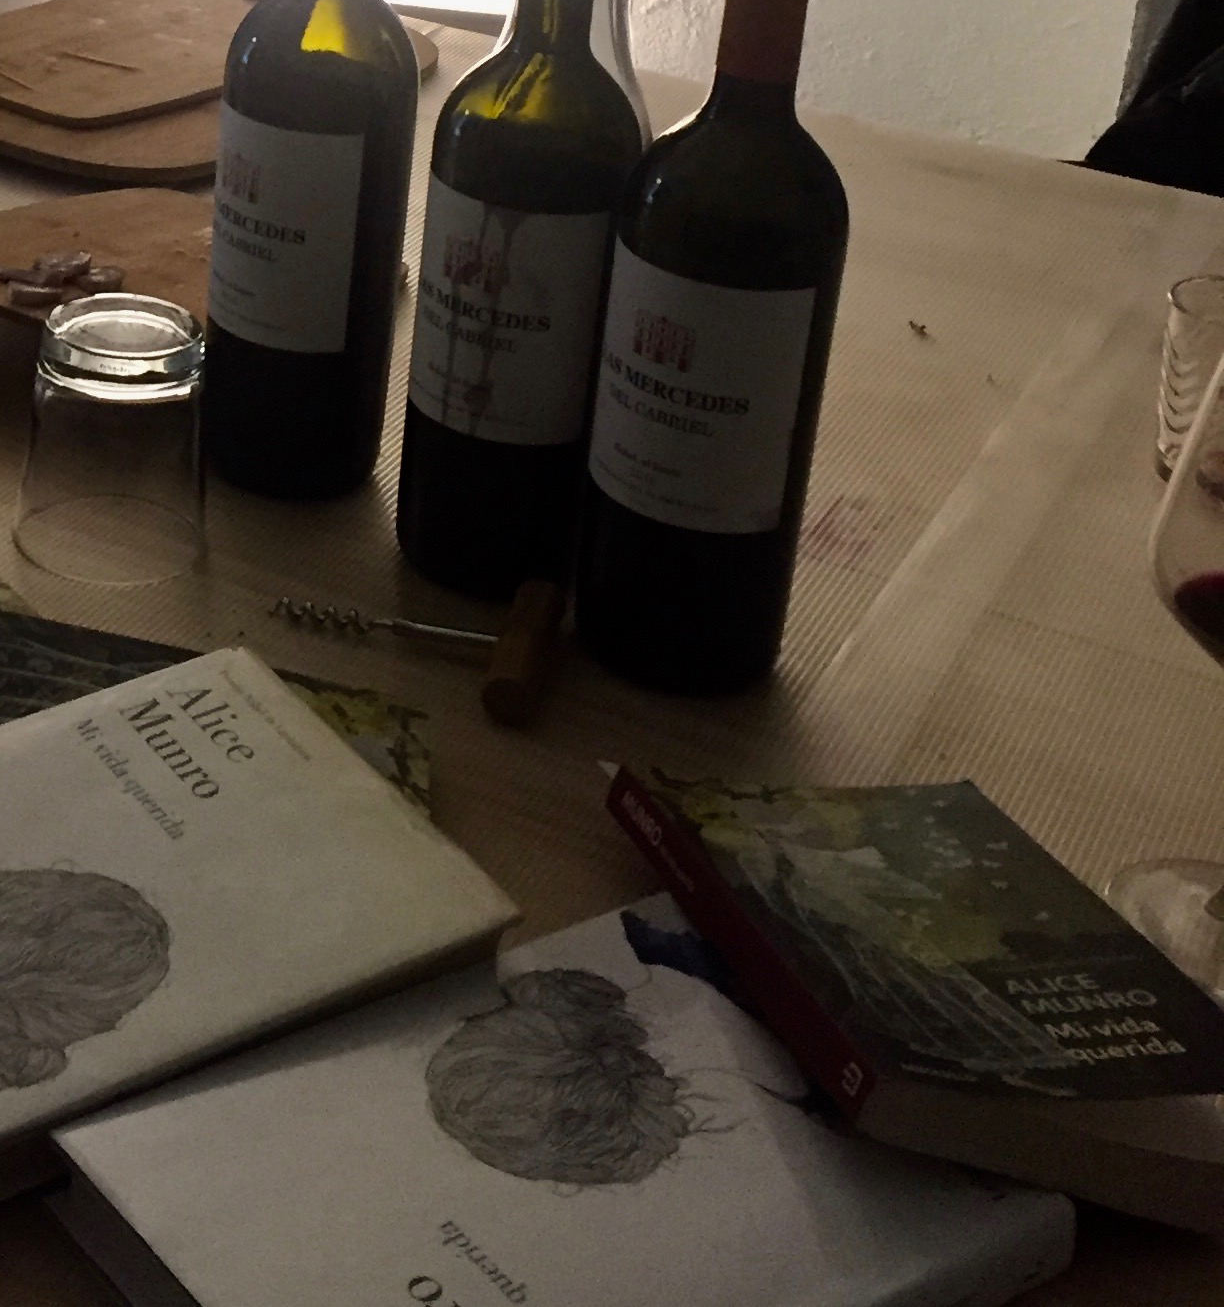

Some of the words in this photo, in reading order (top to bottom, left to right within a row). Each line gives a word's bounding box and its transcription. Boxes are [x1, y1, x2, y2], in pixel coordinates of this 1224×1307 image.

[437, 288, 551, 332] MERCEDES
[626, 365, 750, 416] MERCEDES
[119, 697, 220, 799] Munro
[166, 689, 255, 763] Alice
[77, 718, 98, 742] Mi
[94, 743, 130, 780] vida
[124, 777, 184, 840] querida
[1007, 973, 1101, 995] ALICE
[1022, 990, 1158, 1014] MUNRO
[1093, 1016, 1161, 1037] vida
[1070, 1036, 1187, 1066] querida
[440, 1220, 527, 1304] querida
